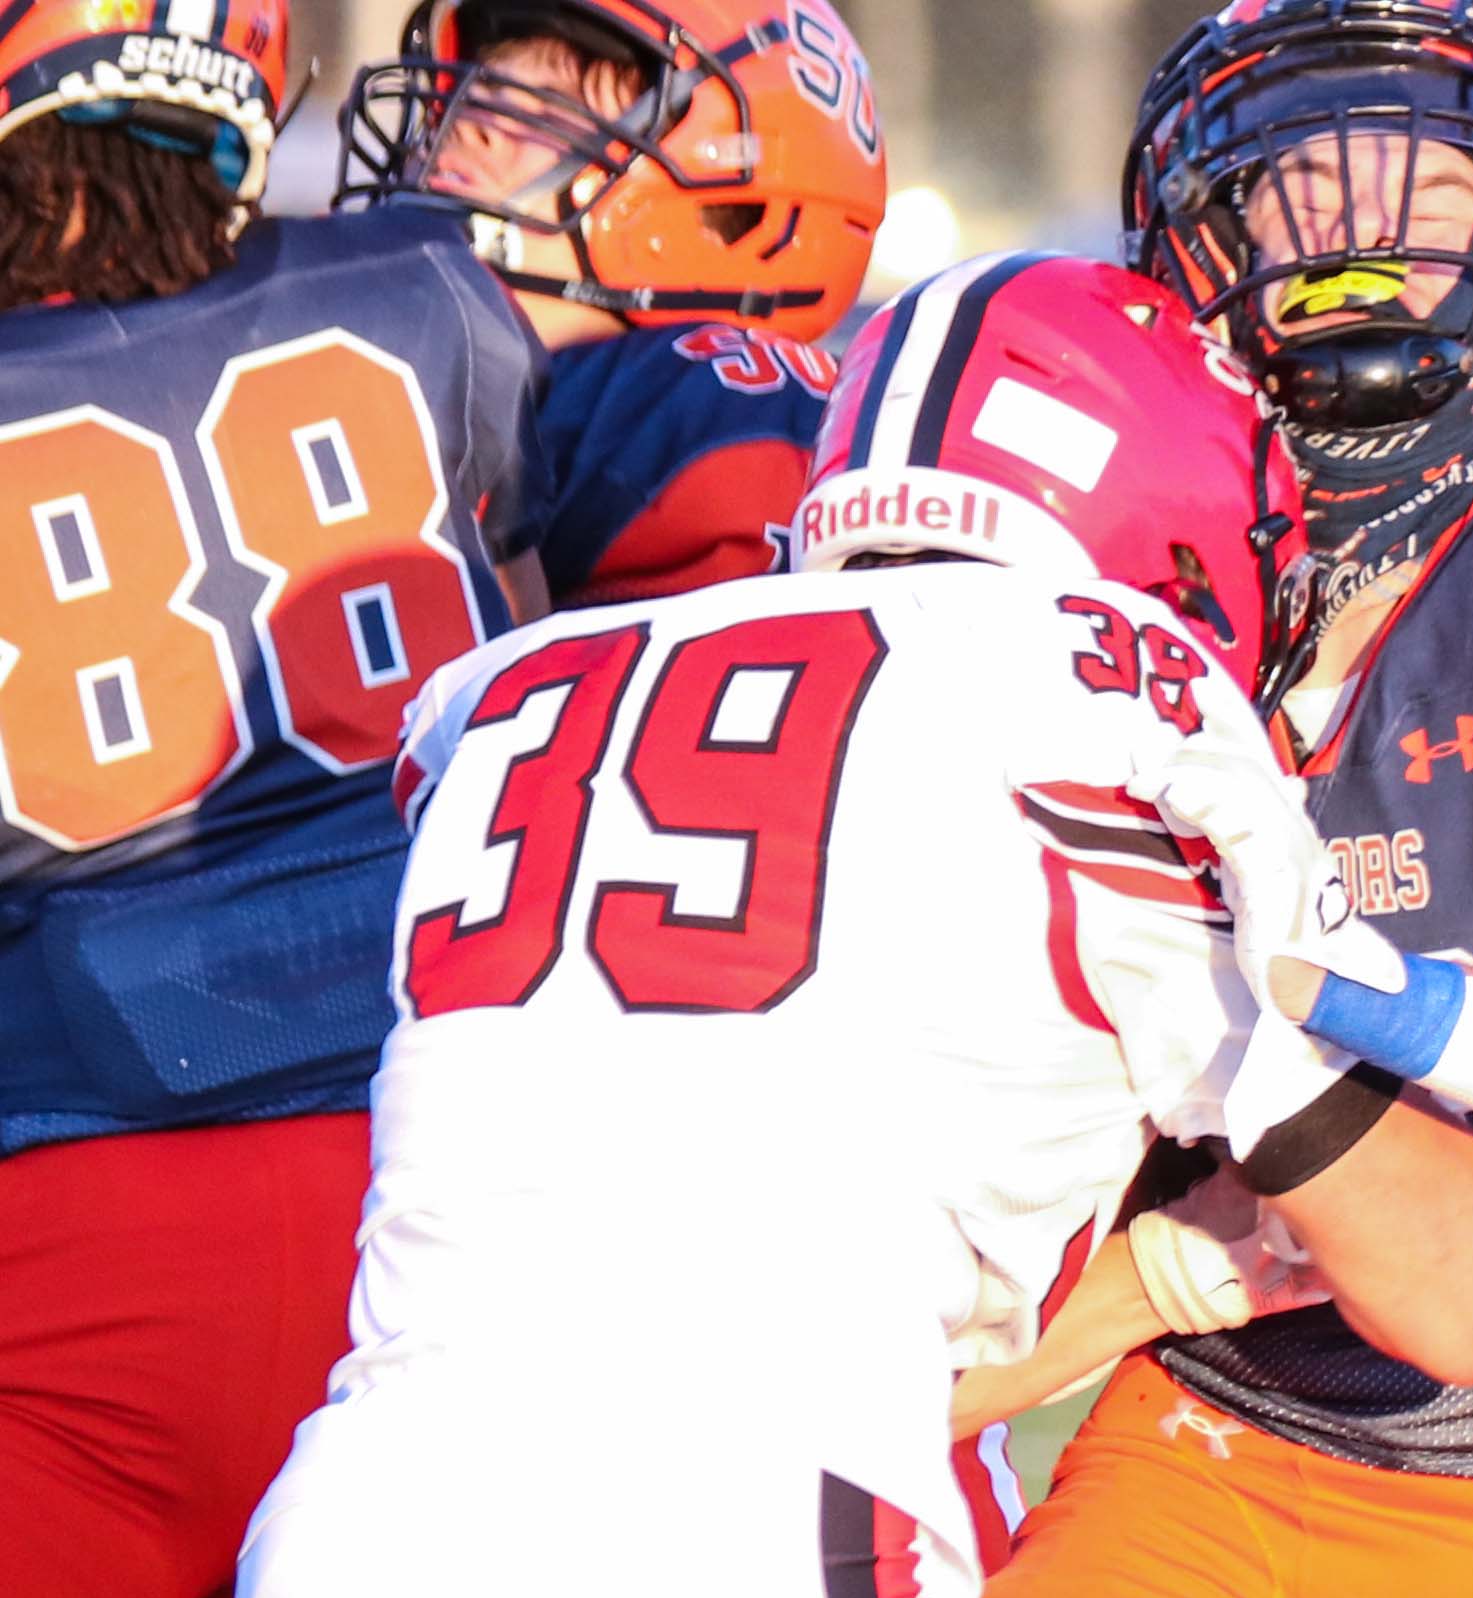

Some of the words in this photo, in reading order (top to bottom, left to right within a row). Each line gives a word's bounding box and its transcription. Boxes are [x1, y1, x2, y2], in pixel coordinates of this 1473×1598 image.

[118, 33, 254, 98] schutt
[0, 326, 487, 853] 88
[802, 483, 1000, 554] Riddell
[1054, 593, 1210, 739] 39
[403, 607, 889, 1020] 39
